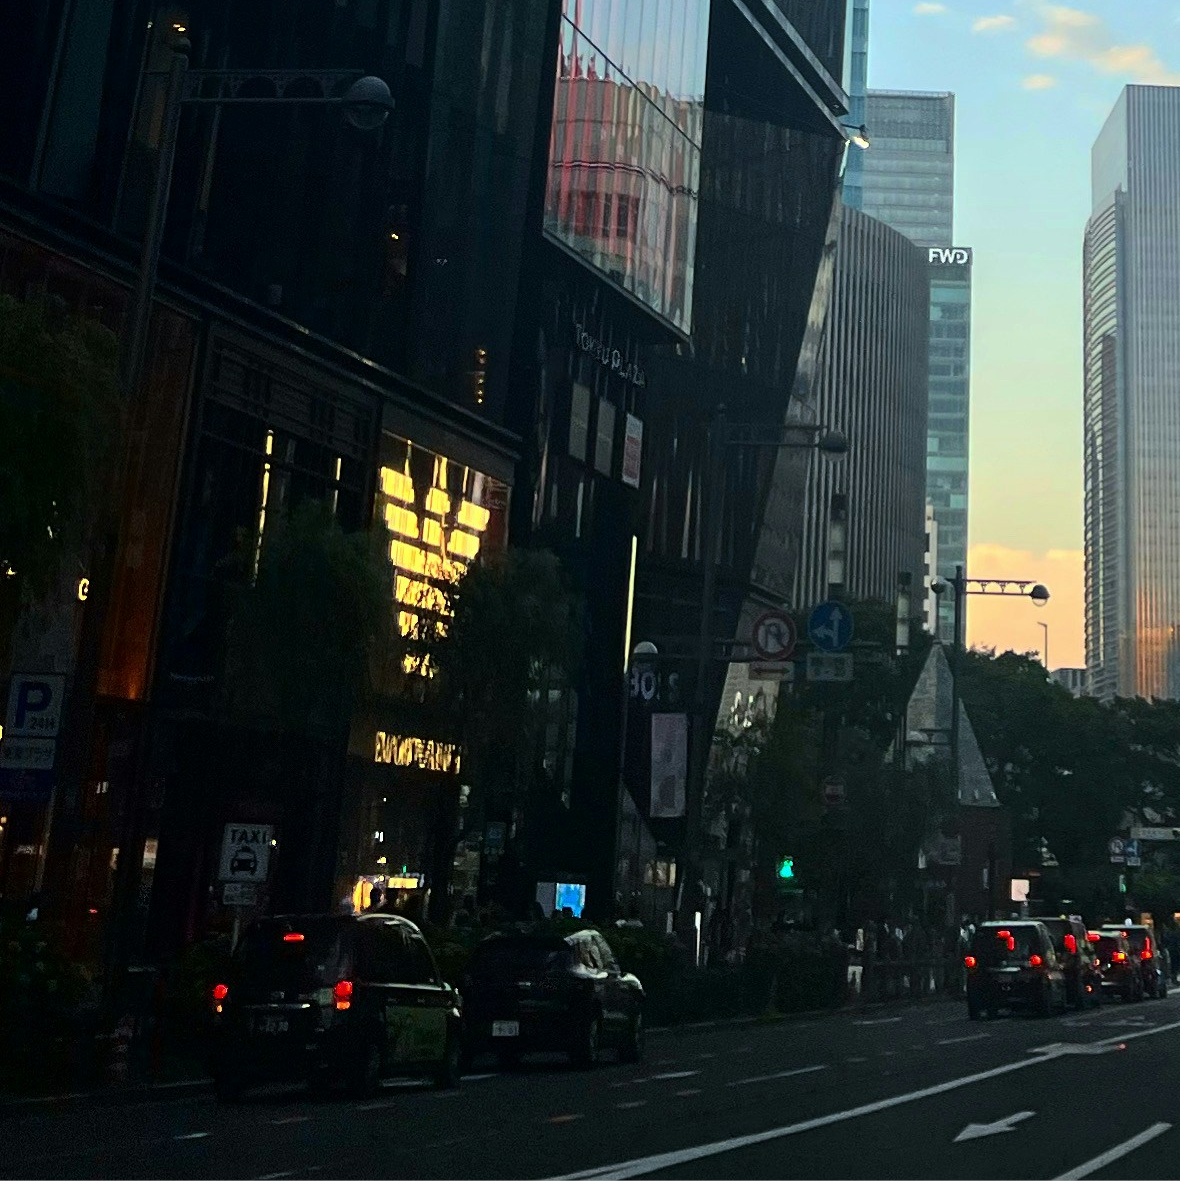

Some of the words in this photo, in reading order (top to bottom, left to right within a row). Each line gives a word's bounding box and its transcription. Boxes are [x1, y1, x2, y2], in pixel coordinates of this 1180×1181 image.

[928, 247, 969, 264] FWD
[14, 681, 52, 729] P
[230, 829, 267, 844] TAXI
